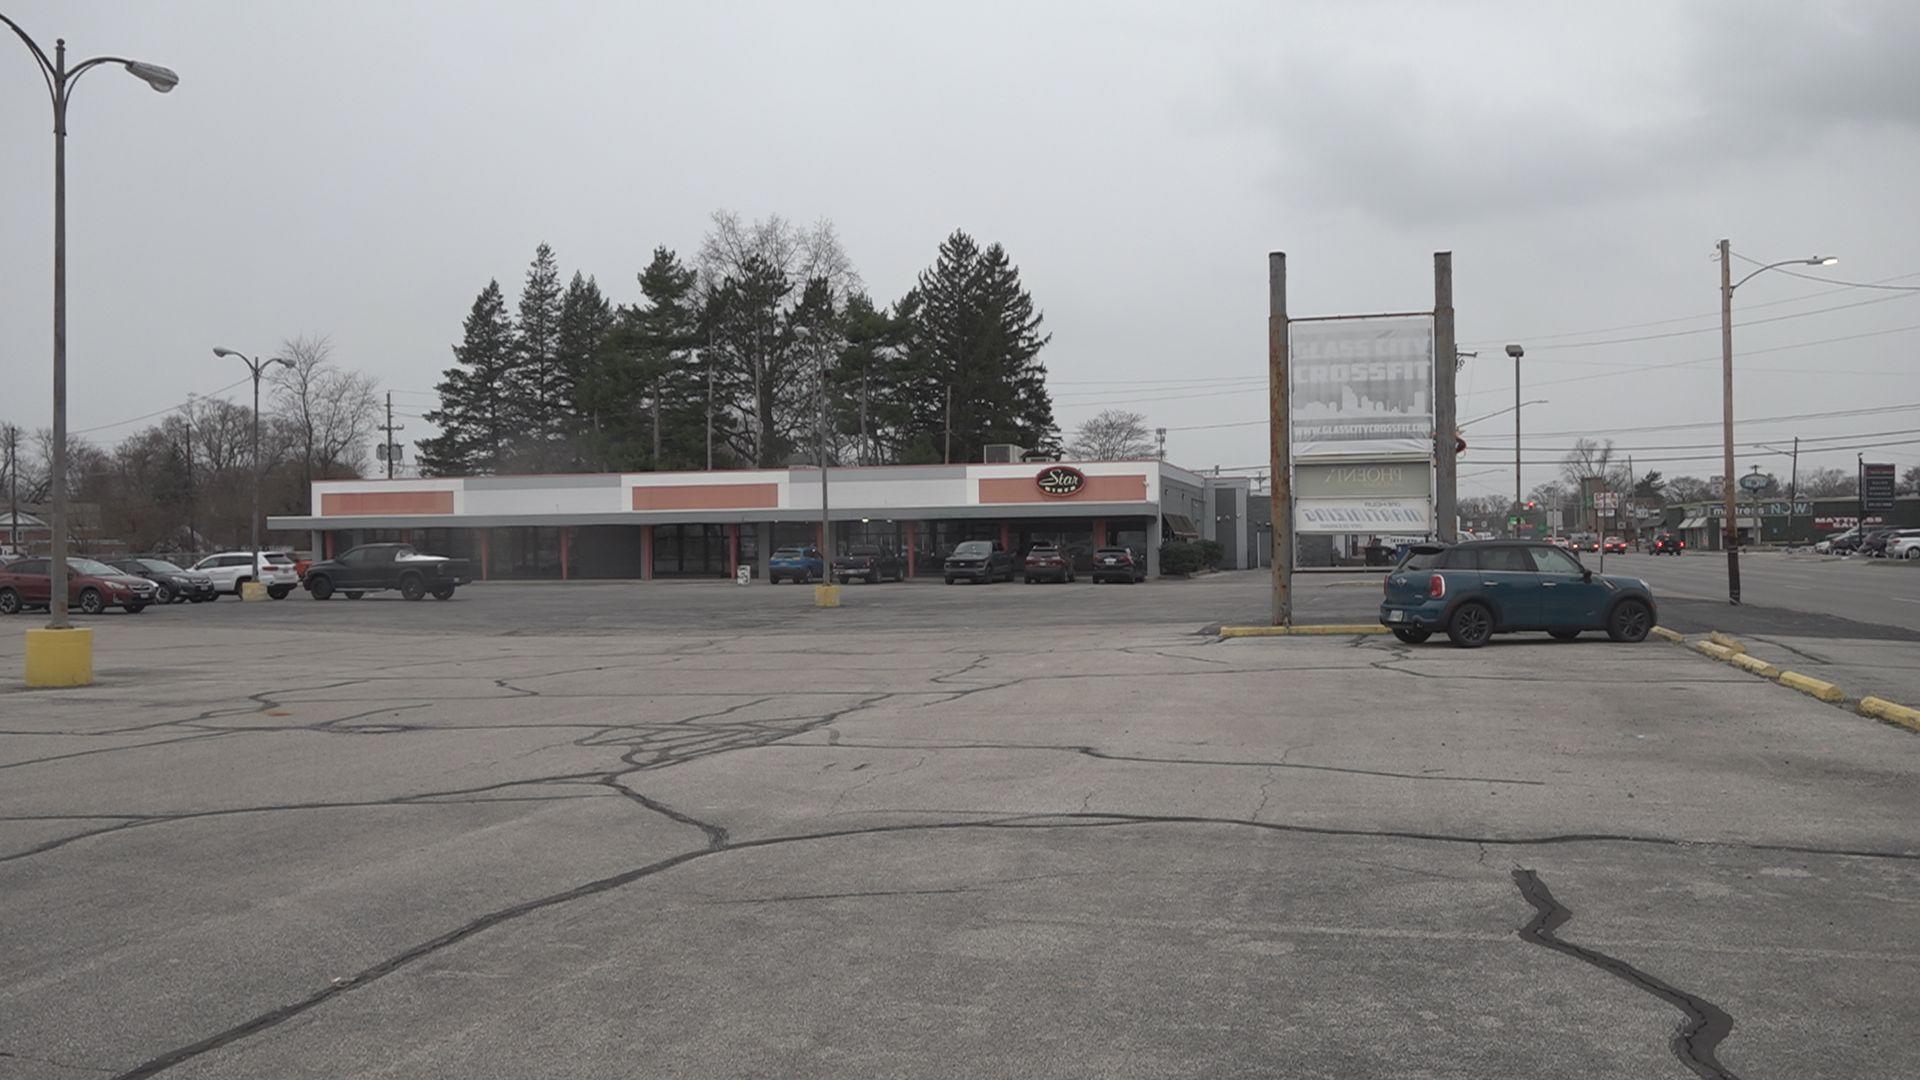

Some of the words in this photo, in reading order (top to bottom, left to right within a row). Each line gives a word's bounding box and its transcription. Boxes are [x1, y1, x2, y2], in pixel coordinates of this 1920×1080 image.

[1294, 361, 1430, 383] CROSSFIT
[1039, 469, 1078, 486] Star
[1815, 516, 1882, 524] MATTRSS
